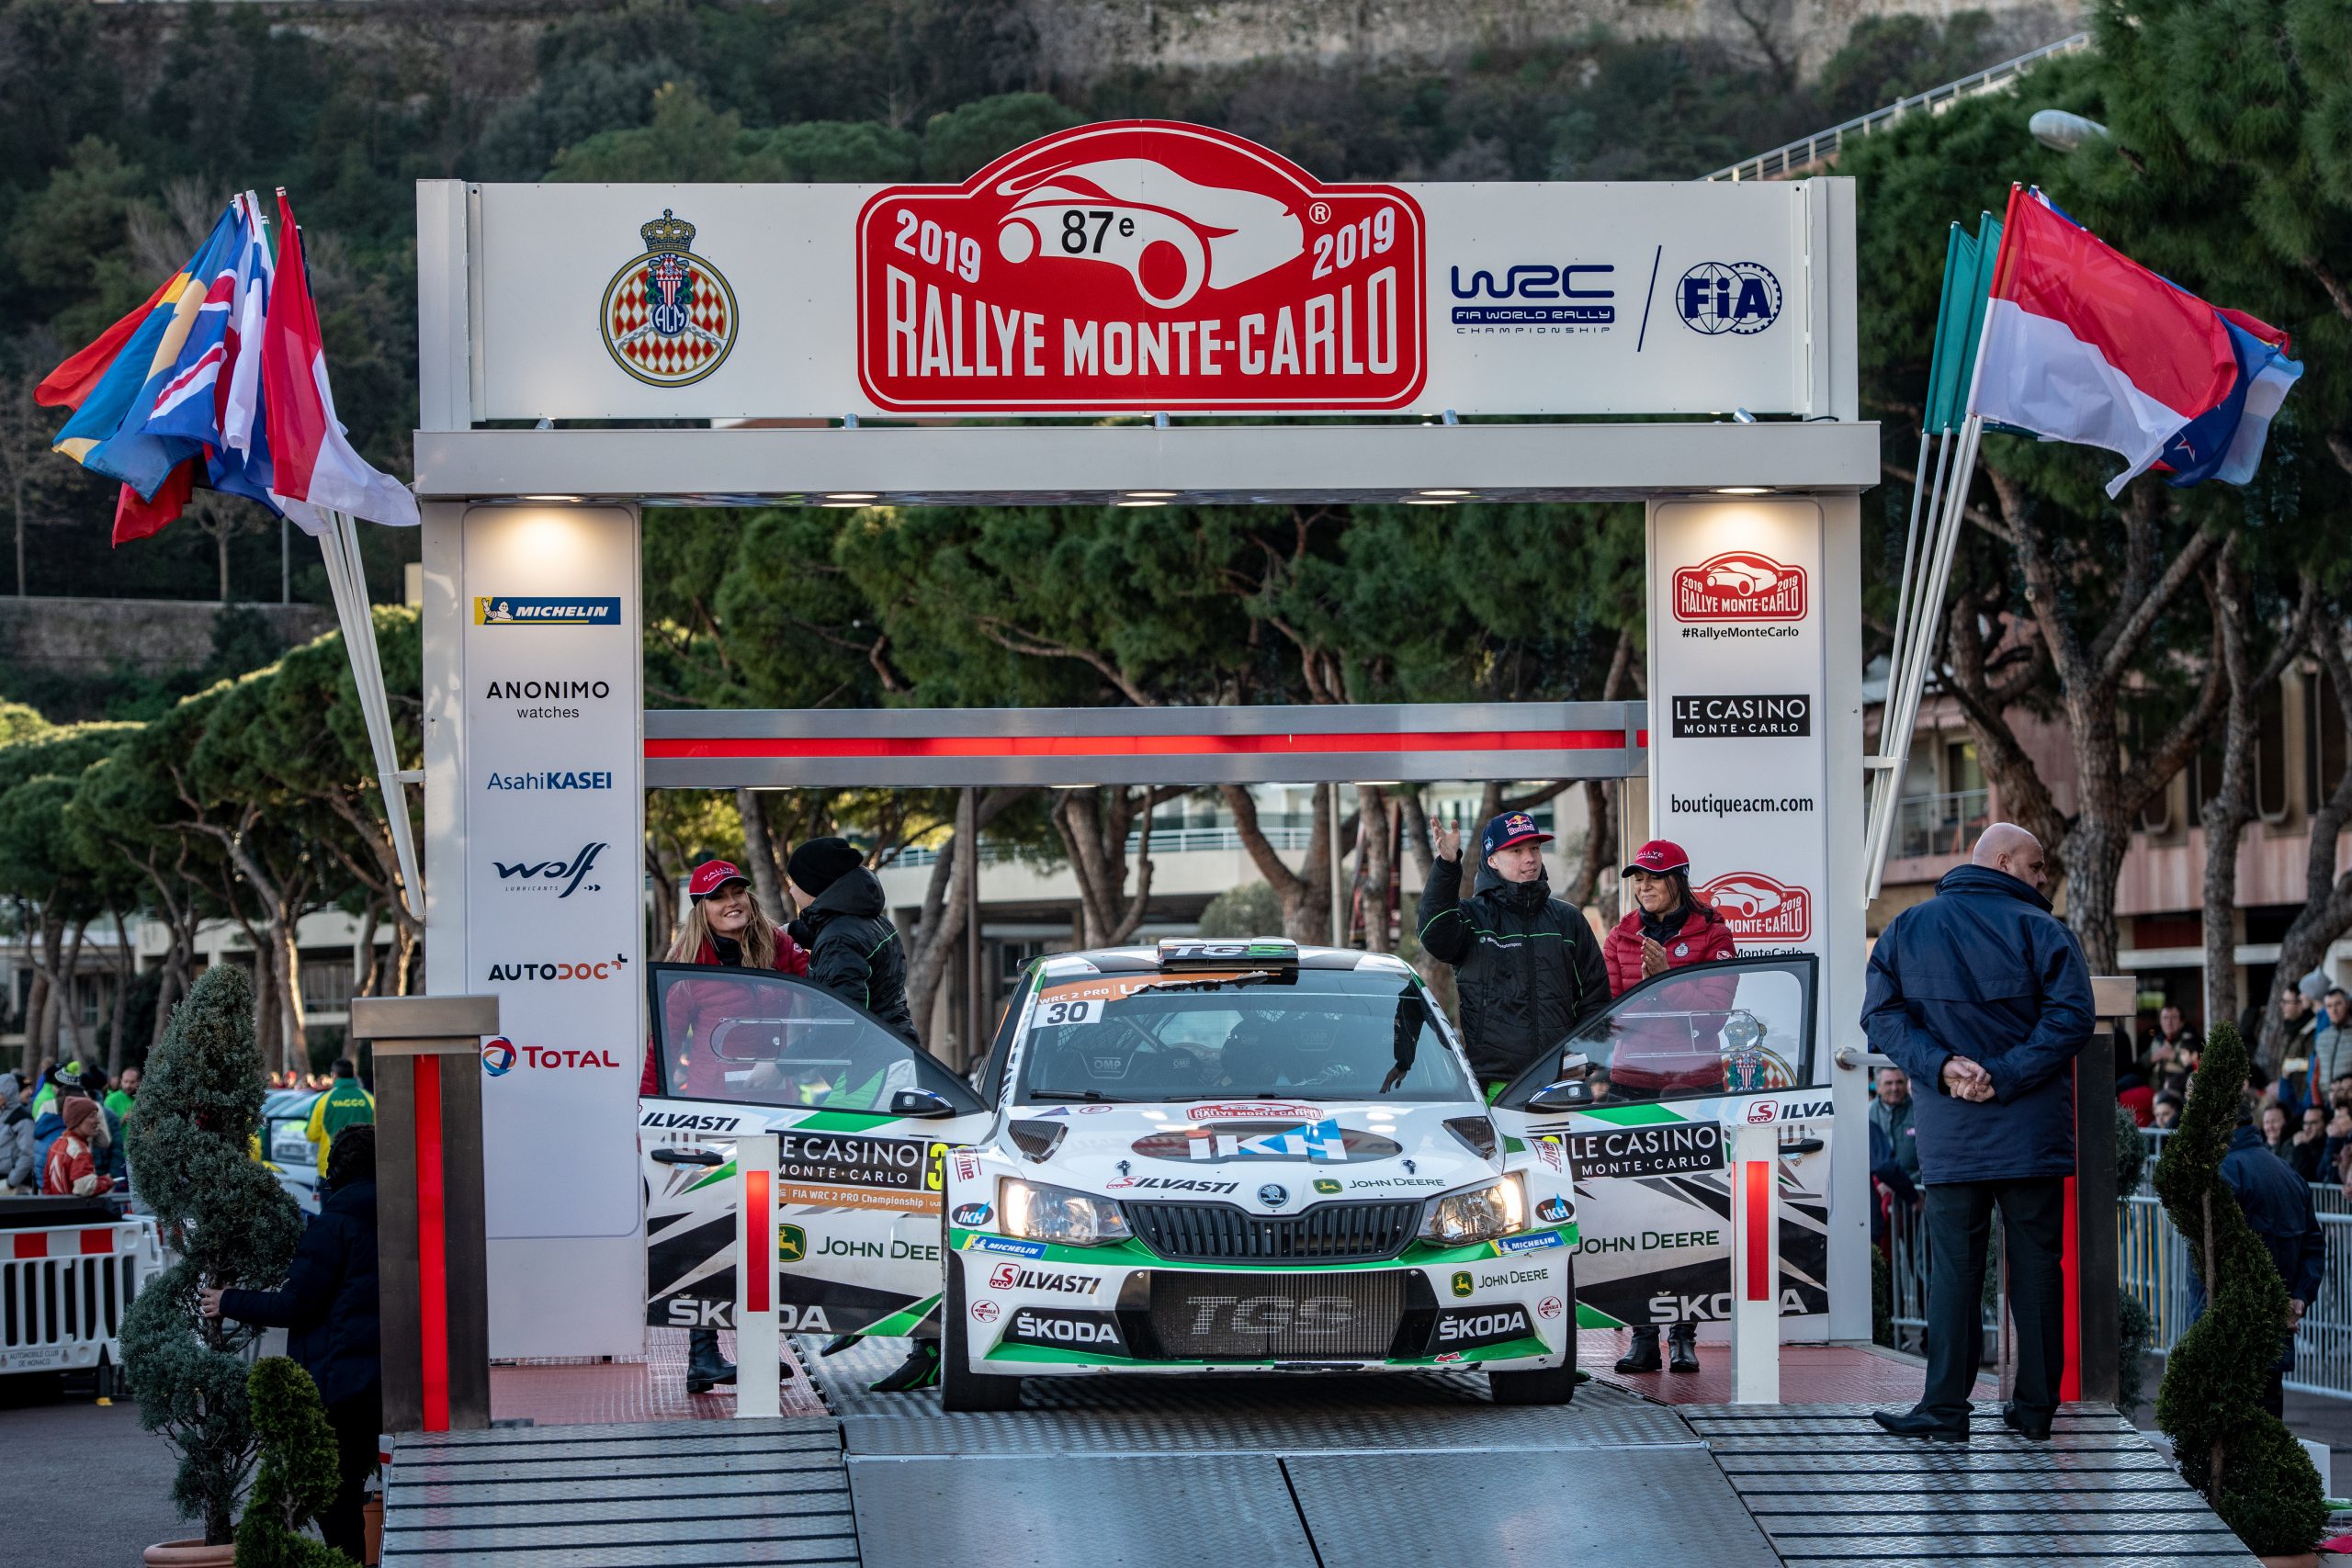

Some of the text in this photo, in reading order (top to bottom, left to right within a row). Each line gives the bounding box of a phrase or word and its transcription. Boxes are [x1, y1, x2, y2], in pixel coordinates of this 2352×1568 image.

[894, 209, 981, 284] 2019
[1312, 206, 1396, 281] 2019
[1451, 265, 1615, 299] WRC
[887, 264, 1397, 378] RALLYE MONTE-CARLO
[1456, 311, 1610, 320] FIA WORLD RALLY
[1682, 576, 1703, 592] 2019
[1778, 575, 1798, 592] 2019
[1681, 586, 1799, 613] RALLYE MONTE-CARLO
[515, 606, 608, 617] MICHELIN
[1682, 626, 1799, 639] #RallyeMonteCarlo
[486, 681, 610, 699] ANONIMO
[517, 706, 579, 718] watches
[1677, 699, 1806, 719] LE CASINO
[1671, 794, 1814, 818] boutiqueacm.com
[1781, 897, 1802, 913] 2019
[1725, 907, 1803, 933] MONTE-CARLO
[488, 963, 609, 981] AUTODOC
[1039, 994, 1067, 1005] WRC
[1083, 987, 1109, 997] PRO
[1046, 1001, 1089, 1024] 30
[1093, 1060, 1122, 1070] OMP
[1194, 1109, 1233, 1118] RALLYE
[1758, 1101, 1835, 1120] SILVA
[640, 1112, 741, 1132] ILVASTI
[783, 1136, 919, 1168] E CASINO
[1570, 1126, 1716, 1160] LE CASINO
[1395, 1178, 1445, 1187] DEERE
[792, 1189, 808, 1199] FIA
[809, 1190, 829, 1200] WRC
[831, 1191, 838, 1201] 2
[840, 1192, 859, 1201] PRO
[861, 1194, 923, 1209] Championship
[988, 1242, 1039, 1255] MICHELIN
[1511, 1236, 1555, 1249] MICHELIN
[1642, 1230, 1720, 1250] DEERE
[890, 1240, 939, 1261] DEE
[1510, 1269, 1549, 1283] DEERE
[668, 1293, 831, 1332] ŠKDA
[1186, 1295, 1353, 1335] TGS
[1649, 1288, 1809, 1324] ŠKOA
[1017, 1312, 1120, 1344] ŠKODA
[1439, 1311, 1526, 1341] ŠKODA
[45, 1349, 59, 1358] CLUB
